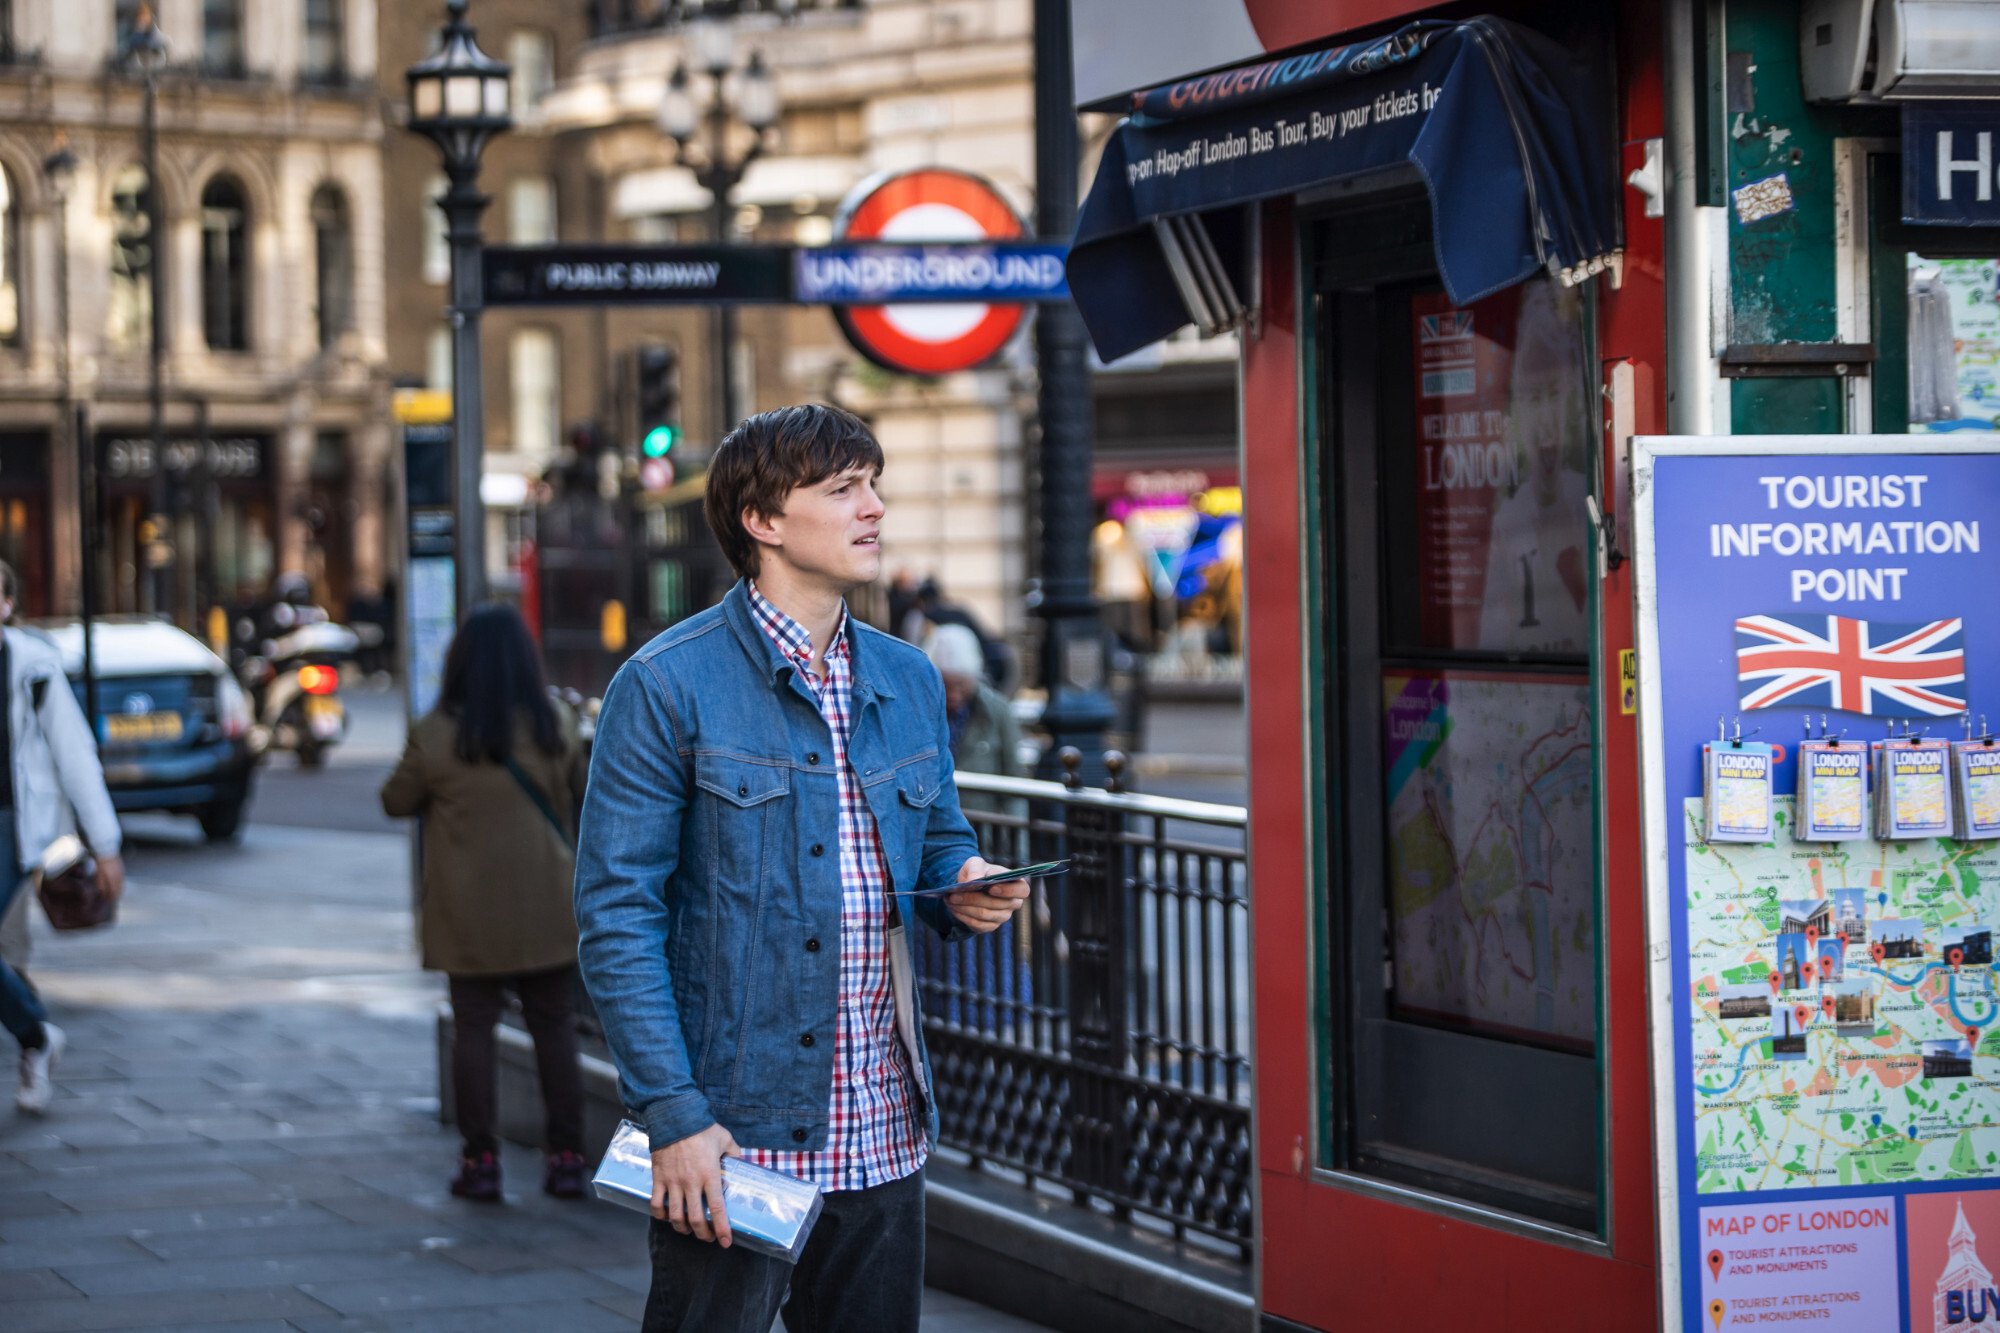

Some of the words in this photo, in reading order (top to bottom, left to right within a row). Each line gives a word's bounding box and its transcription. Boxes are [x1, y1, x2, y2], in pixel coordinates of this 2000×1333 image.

[1156, 140, 1201, 177] Hop-off
[1203, 132, 1248, 165] London
[1251, 127, 1275, 154] Bus
[1275, 119, 1308, 147] Tour,
[1310, 111, 1337, 141] Buy
[1340, 105, 1371, 137] your
[1374, 89, 1419, 123] tickets
[1937, 130, 2000, 201] H
[546, 262, 628, 290] PUBLIC
[629, 261, 720, 289] SUBWAY
[803, 254, 1066, 291] UNDERGROUND
[1424, 441, 1519, 490] LONDON
[1759, 474, 1928, 509] TOURIST
[1710, 520, 1980, 557] INFORMATION
[1791, 568, 1908, 602] POINT
[1719, 755, 1765, 769] LONDON
[1814, 753, 1860, 767] LONDON
[1895, 752, 1941, 765] LONDON
[1742, 770, 1765, 779] MAP
[1836, 767, 1858, 776] MAP
[1918, 764, 1941, 773] MAP
[1707, 1216, 1756, 1237] MAP
[1763, 1213, 1791, 1233] OF
[1799, 1208, 1889, 1231] LONDON
[1729, 1248, 1775, 1260] TOURIST
[1780, 1243, 1857, 1257] ATTRACTIONS
[1729, 1265, 1753, 1275] AND
[1756, 1260, 1828, 1273] MONUMENTS
[1731, 1297, 1777, 1309] TOURIST
[1782, 1291, 1860, 1306] ATTRACTIONS
[1732, 1314, 1755, 1324] AND
[1759, 1308, 1830, 1322] MONUMENTS
